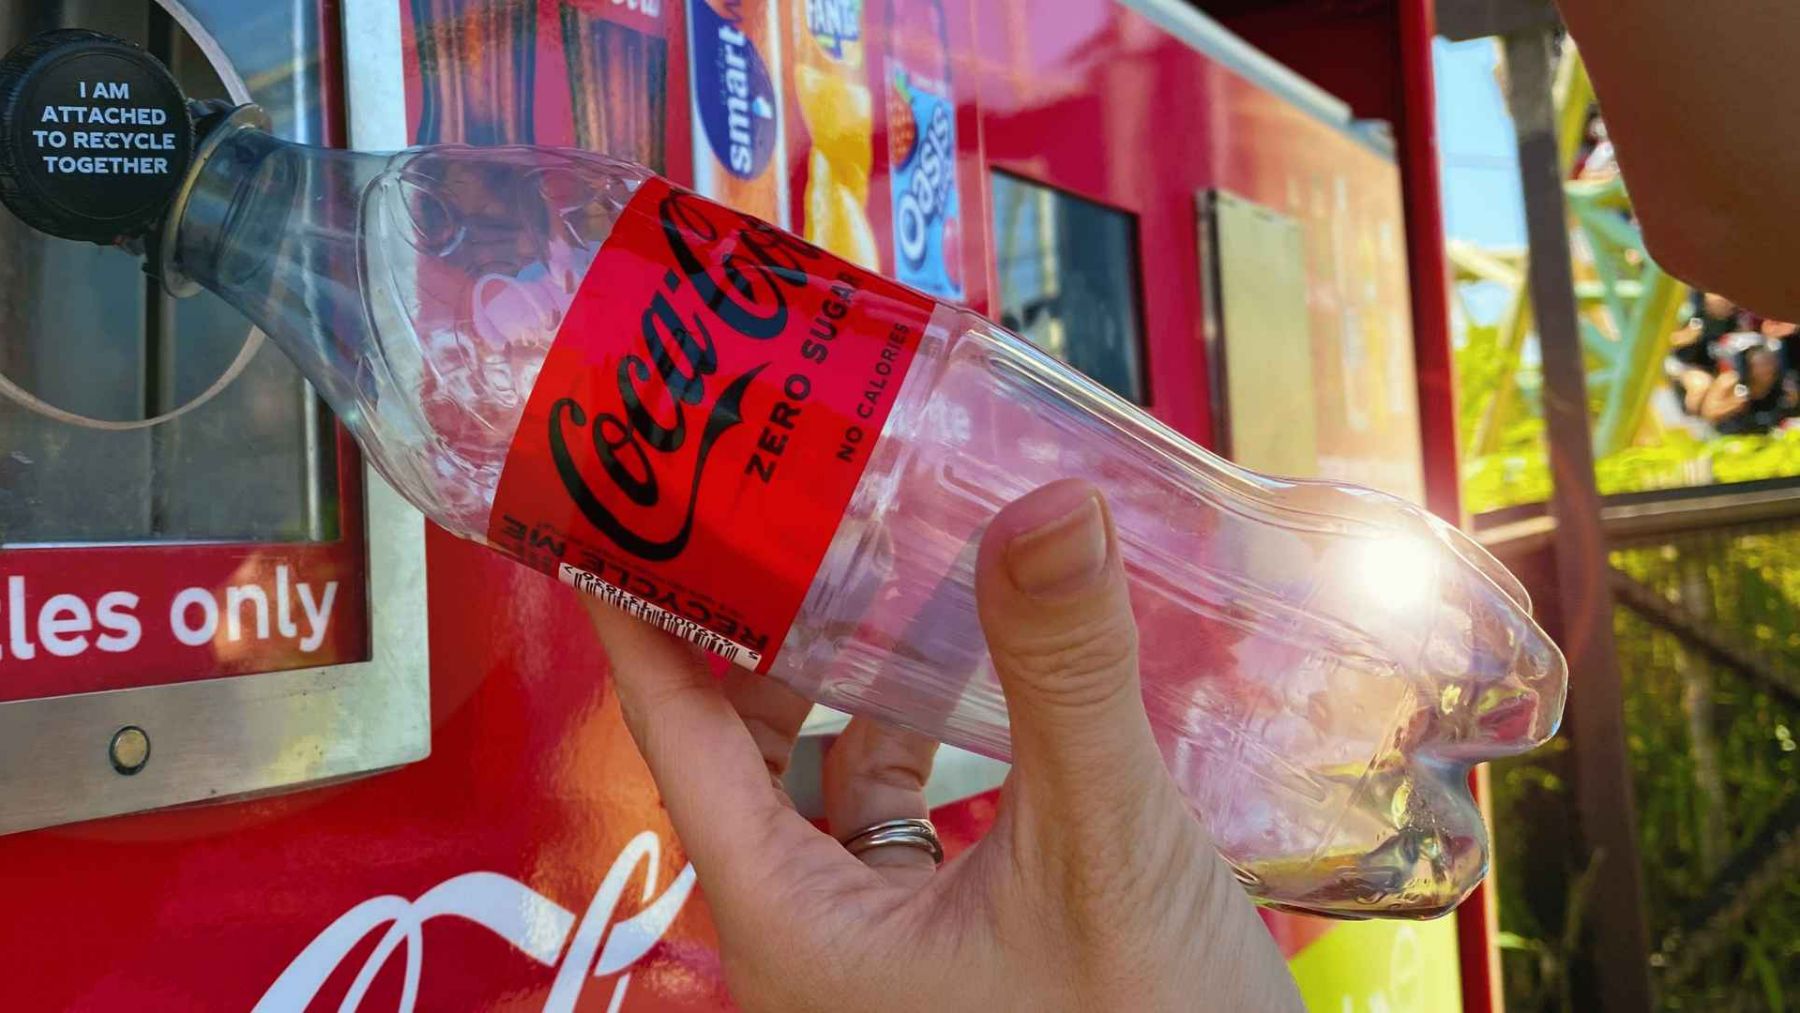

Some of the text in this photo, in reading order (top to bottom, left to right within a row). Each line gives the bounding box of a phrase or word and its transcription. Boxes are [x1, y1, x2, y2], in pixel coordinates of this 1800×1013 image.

[41, 105, 167, 126] ATTACHED
[79, 81, 130, 100] I AM
[719, 25, 753, 174] smart
[32, 130, 176, 150] TO RECYCLE
[43, 155, 169, 175] TOGETHER
[899, 104, 950, 261] Oasis
[744, 272, 862, 484] ZERO SUGAR
[836, 322, 910, 463] NO CALORIES
[501, 513, 567, 558] ME
[0, 565, 340, 661] les only
[579, 547, 769, 652] RECYCLE
